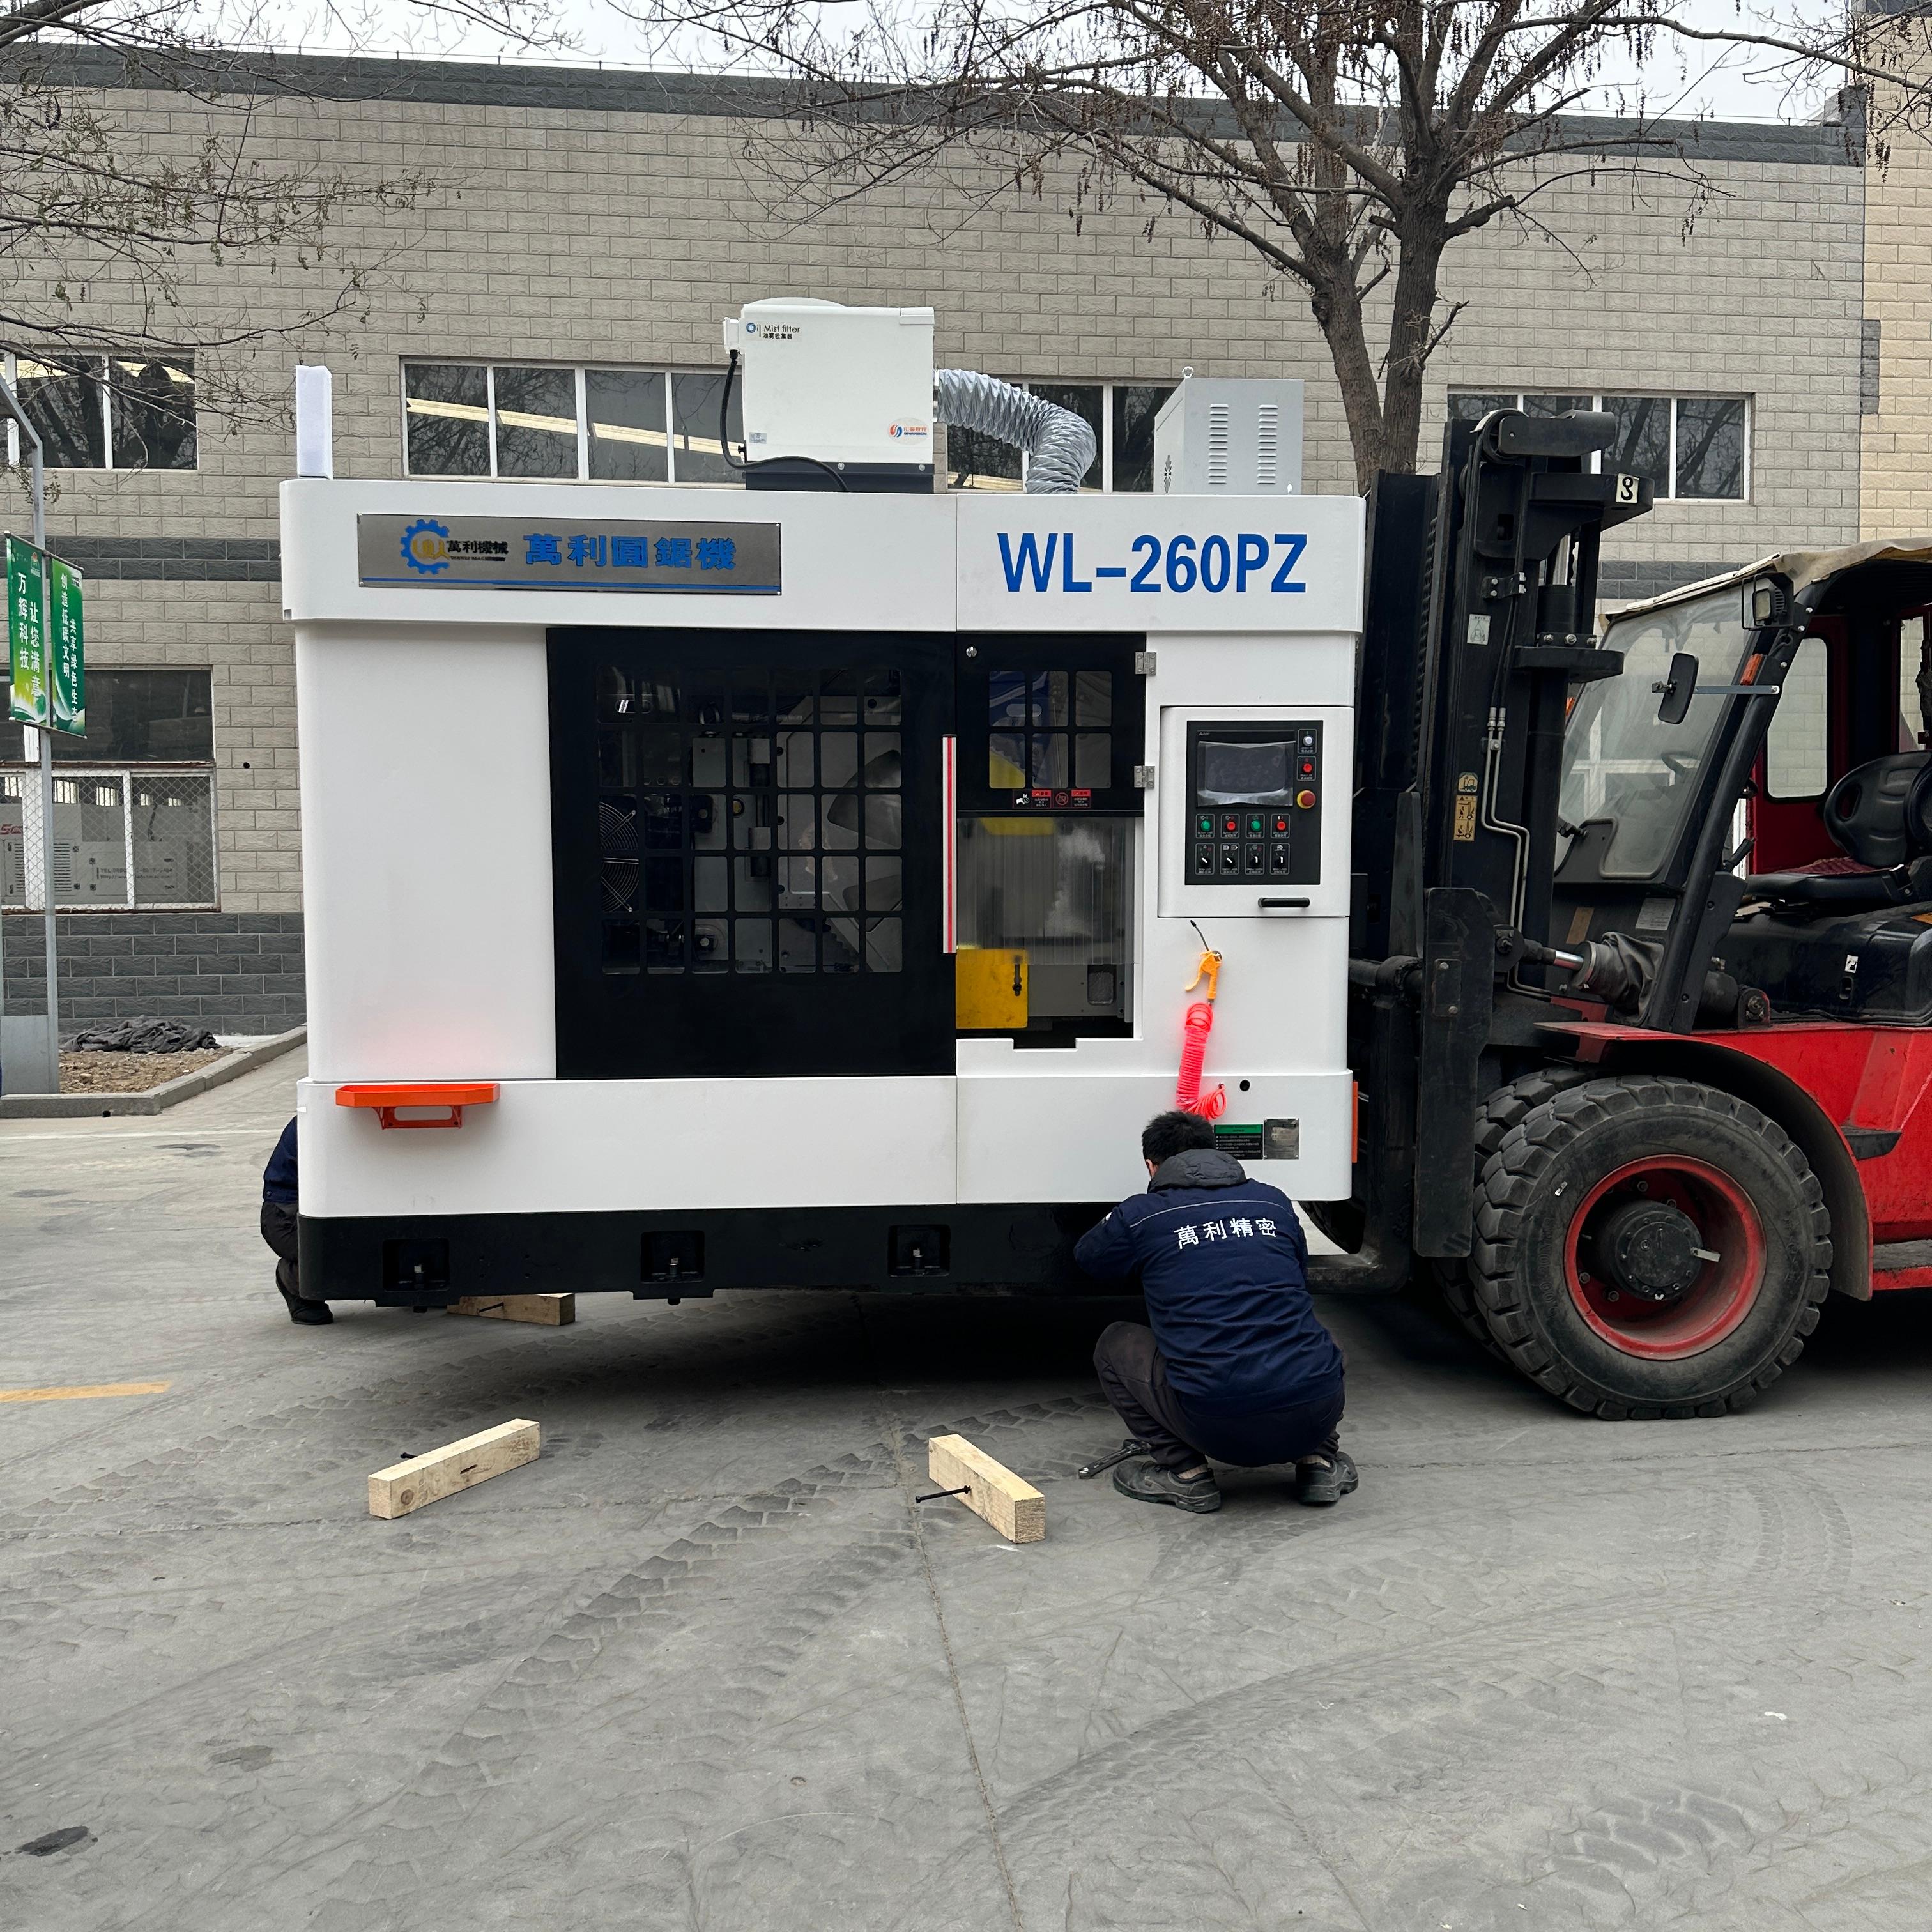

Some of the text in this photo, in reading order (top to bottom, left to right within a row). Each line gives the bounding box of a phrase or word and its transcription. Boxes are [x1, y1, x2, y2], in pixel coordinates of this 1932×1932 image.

[782, 325, 801, 333] filter
[447, 540, 509, 555] 萬利機械
[523, 533, 737, 571] 萬利圓鋸機
[997, 533, 1308, 594] WL-260PZ
[17, 572, 29, 671] 万辉科技
[29, 601, 42, 698] 让您满意
[1174, 1217, 1276, 1249] 萬利精密
